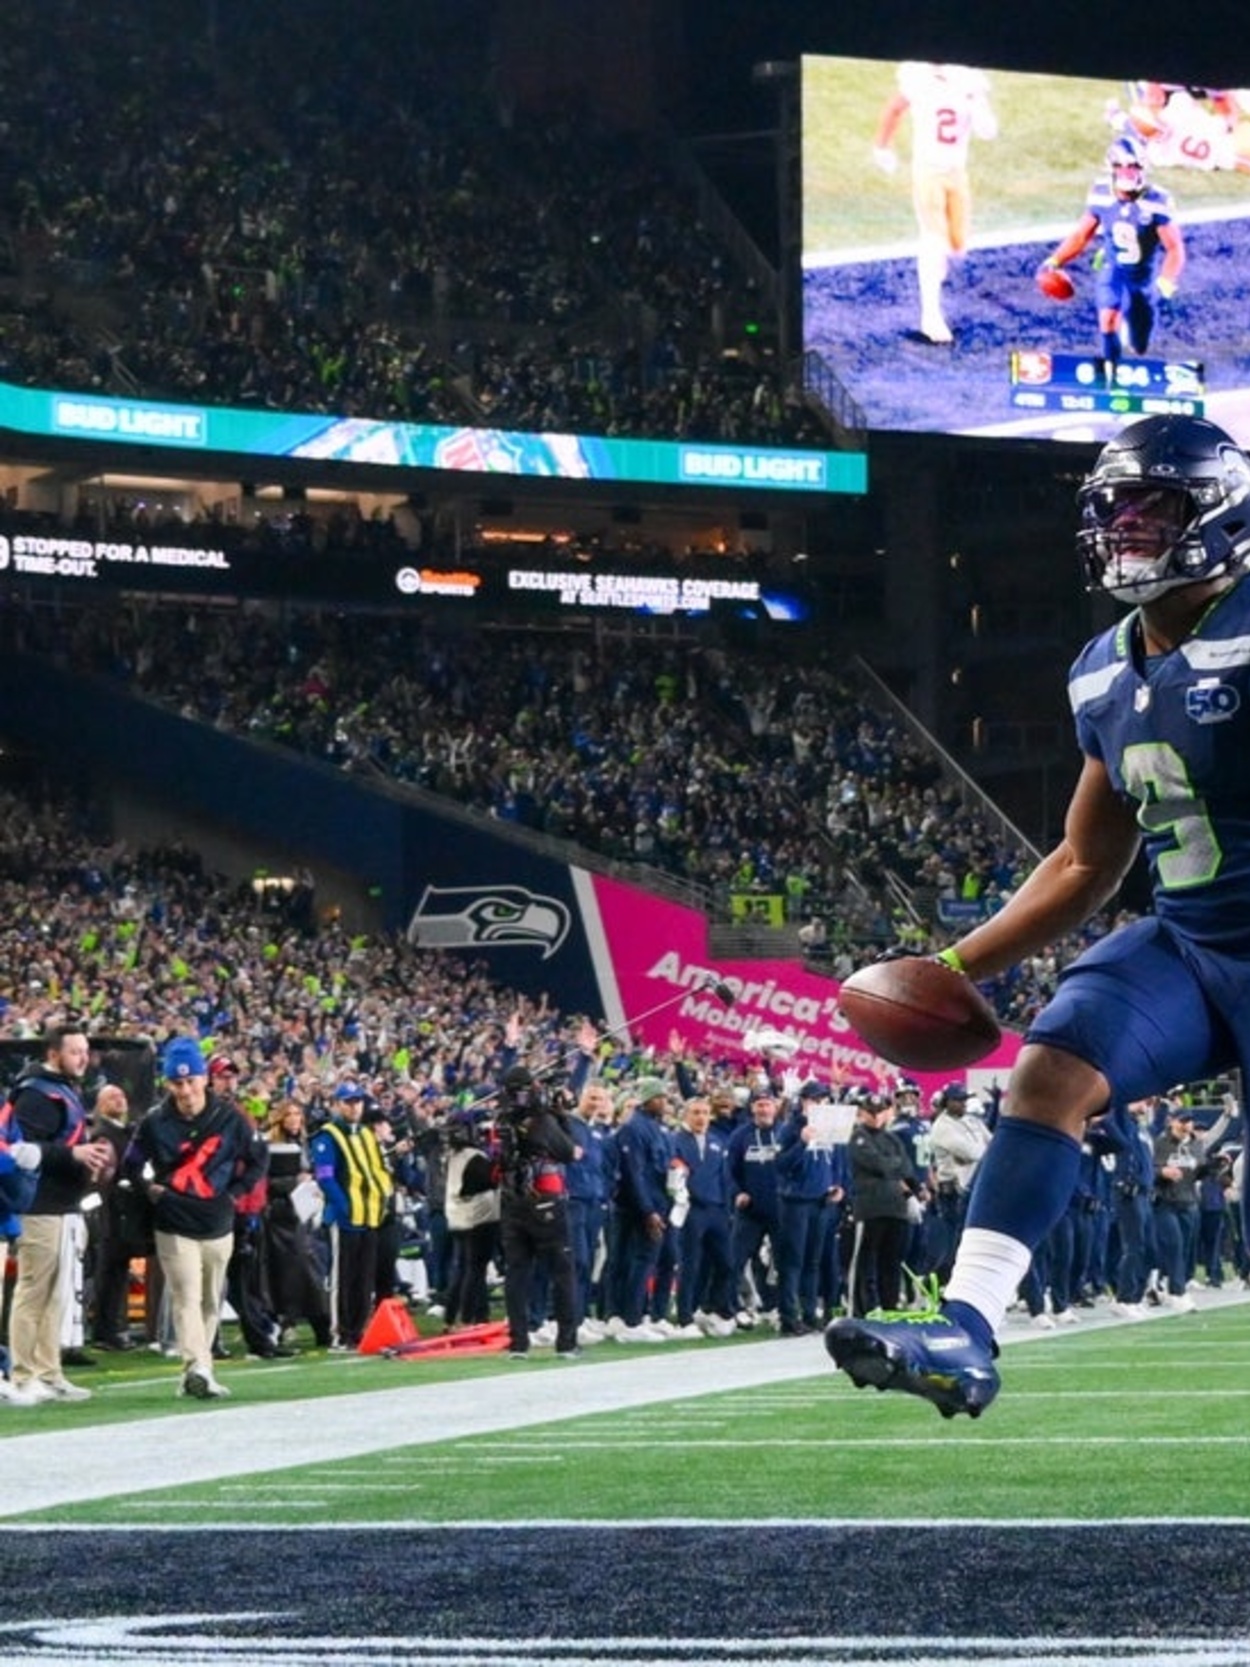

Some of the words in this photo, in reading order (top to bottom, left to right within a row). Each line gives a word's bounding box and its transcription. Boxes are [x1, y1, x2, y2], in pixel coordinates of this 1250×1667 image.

[936, 108, 958, 144] 2
[1112, 222, 1141, 265] 9
[57, 402, 110, 430] BUD
[119, 408, 198, 438] LIGHT
[685, 453, 742, 479] BUD
[745, 456, 823, 483] LIGHT
[13, 536, 93, 559] STOPPED
[95, 543, 133, 562] FOR
[136, 546, 150, 563] A
[151, 546, 229, 568] MEDICAL
[509, 570, 591, 591] EXCLUSIVE
[596, 575, 678, 596] SEAHAWKS
[682, 580, 759, 600] COVERAGE
[1122, 742, 1222, 889] 9
